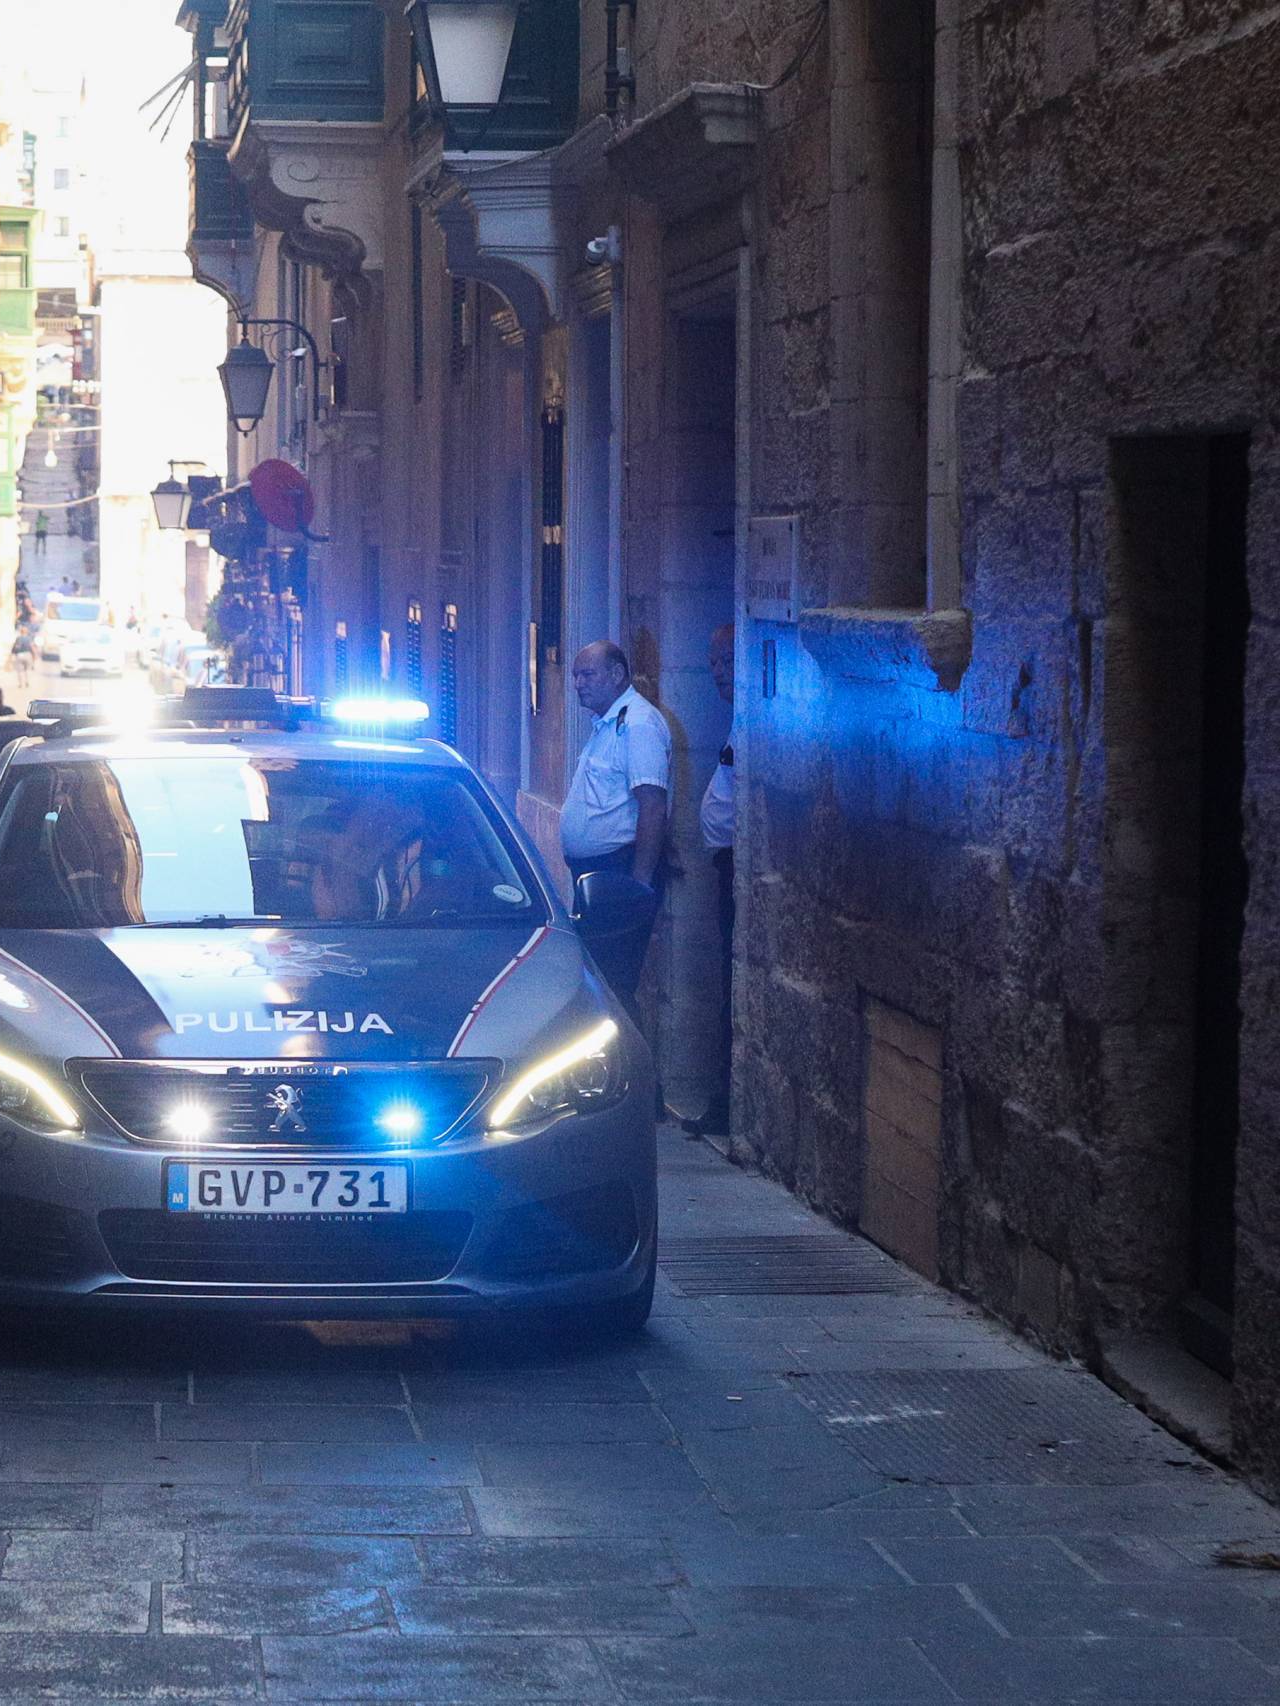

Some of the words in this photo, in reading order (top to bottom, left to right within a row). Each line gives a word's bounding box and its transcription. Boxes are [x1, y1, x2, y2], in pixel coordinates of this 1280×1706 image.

[174, 1010, 395, 1035] PULIZIJA
[197, 1169, 391, 1208] GVP-731
[172, 1192, 184, 1204] M
[203, 1212, 257, 1221] Michael
[266, 1213, 312, 1221] Attard
[320, 1213, 373, 1222] Limited
